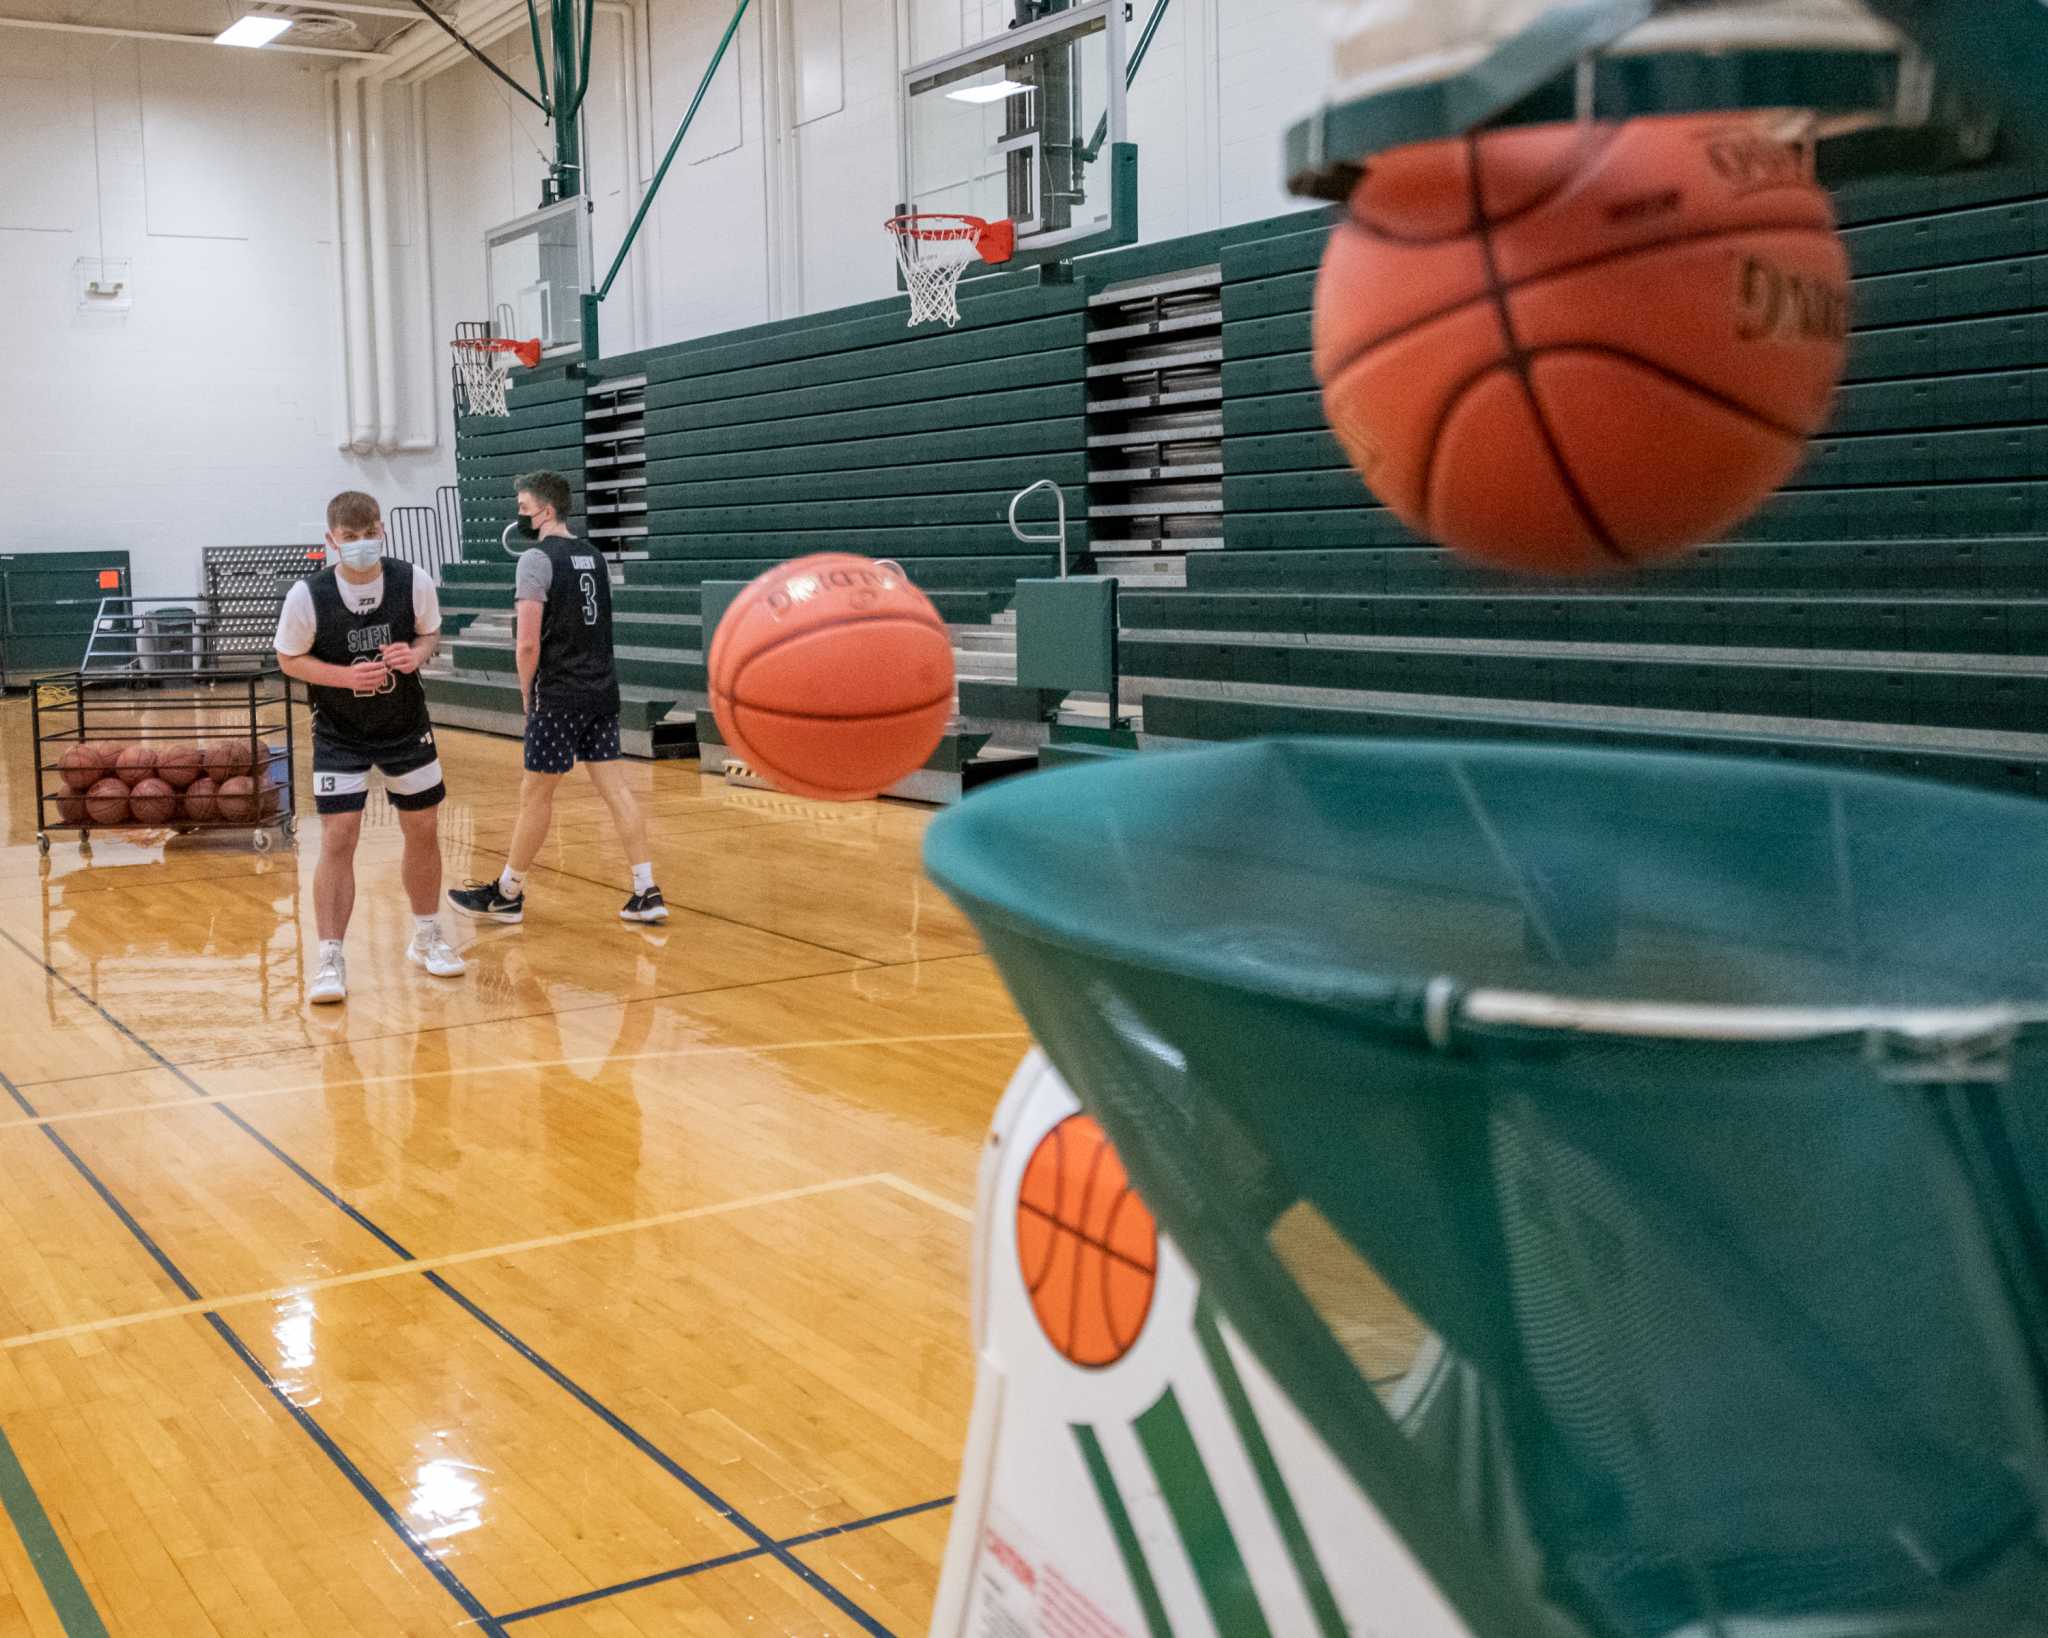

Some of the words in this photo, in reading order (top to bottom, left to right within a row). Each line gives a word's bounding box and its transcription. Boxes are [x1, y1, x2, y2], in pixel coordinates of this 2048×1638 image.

[579, 573, 598, 625] 3
[347, 623, 392, 653] SHEN
[320, 775, 336, 792] 13
